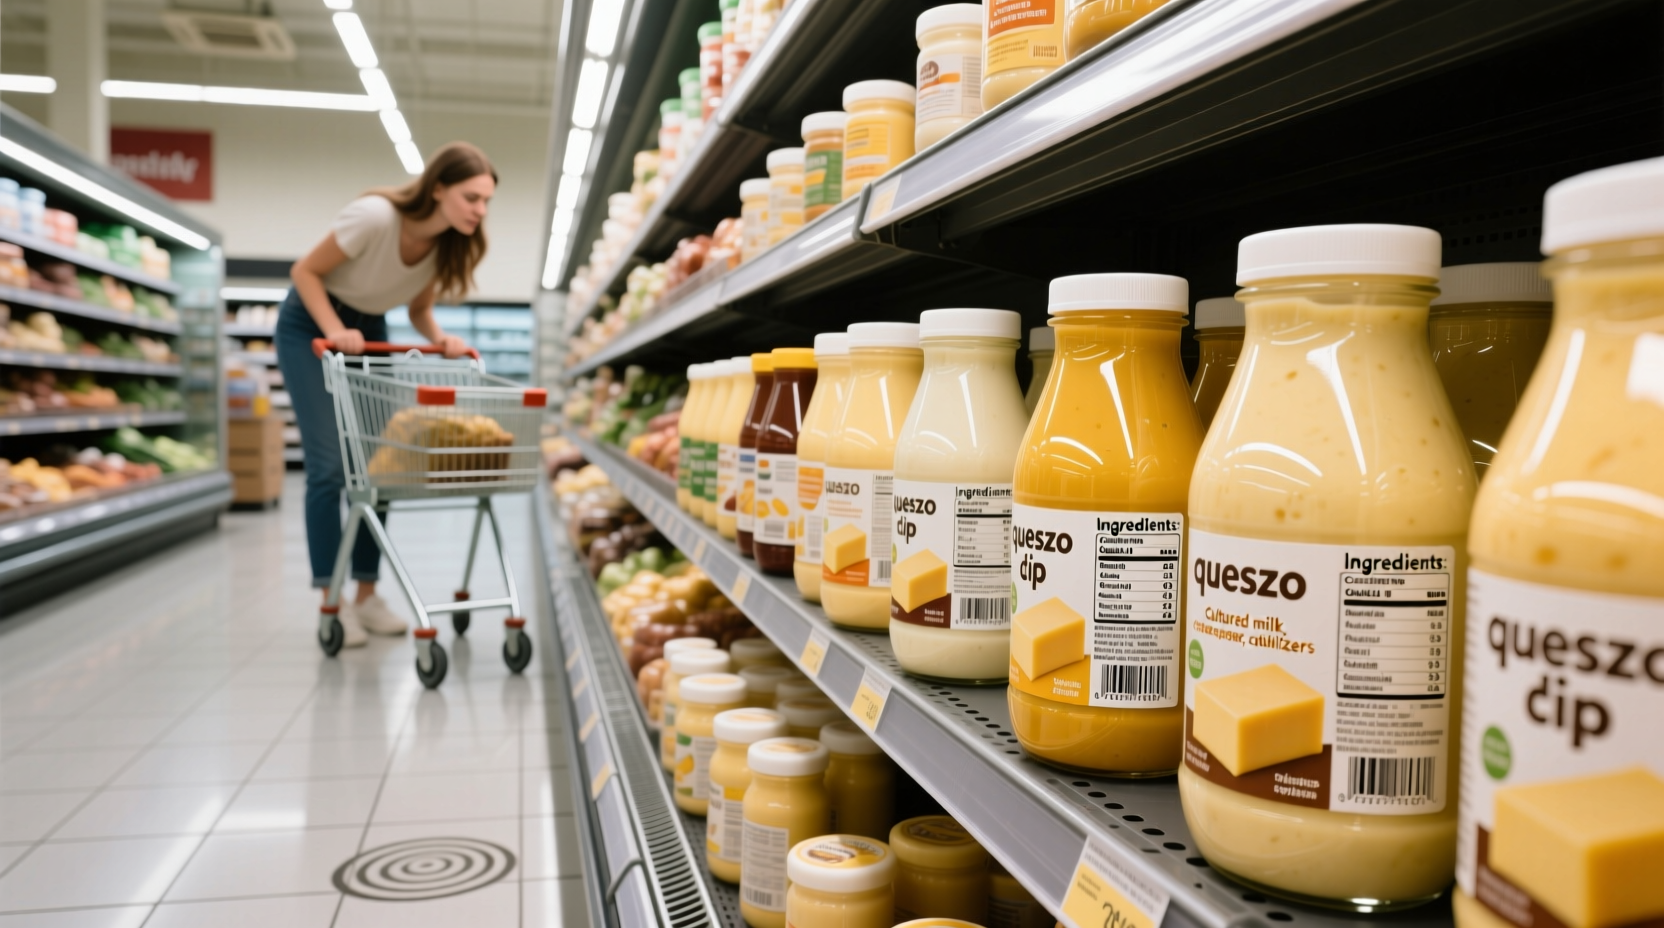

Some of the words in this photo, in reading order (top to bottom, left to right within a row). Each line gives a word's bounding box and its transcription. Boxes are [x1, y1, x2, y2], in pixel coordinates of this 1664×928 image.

[897, 515, 917, 545] dip
[1013, 525, 1073, 554] queszo
[1097, 517, 1180, 536] Ingredients:
[1020, 553, 1046, 590] dip
[1344, 552, 1447, 575] Ingredients:
[1194, 557, 1306, 601] queszo
[1526, 675, 1611, 750] dip
